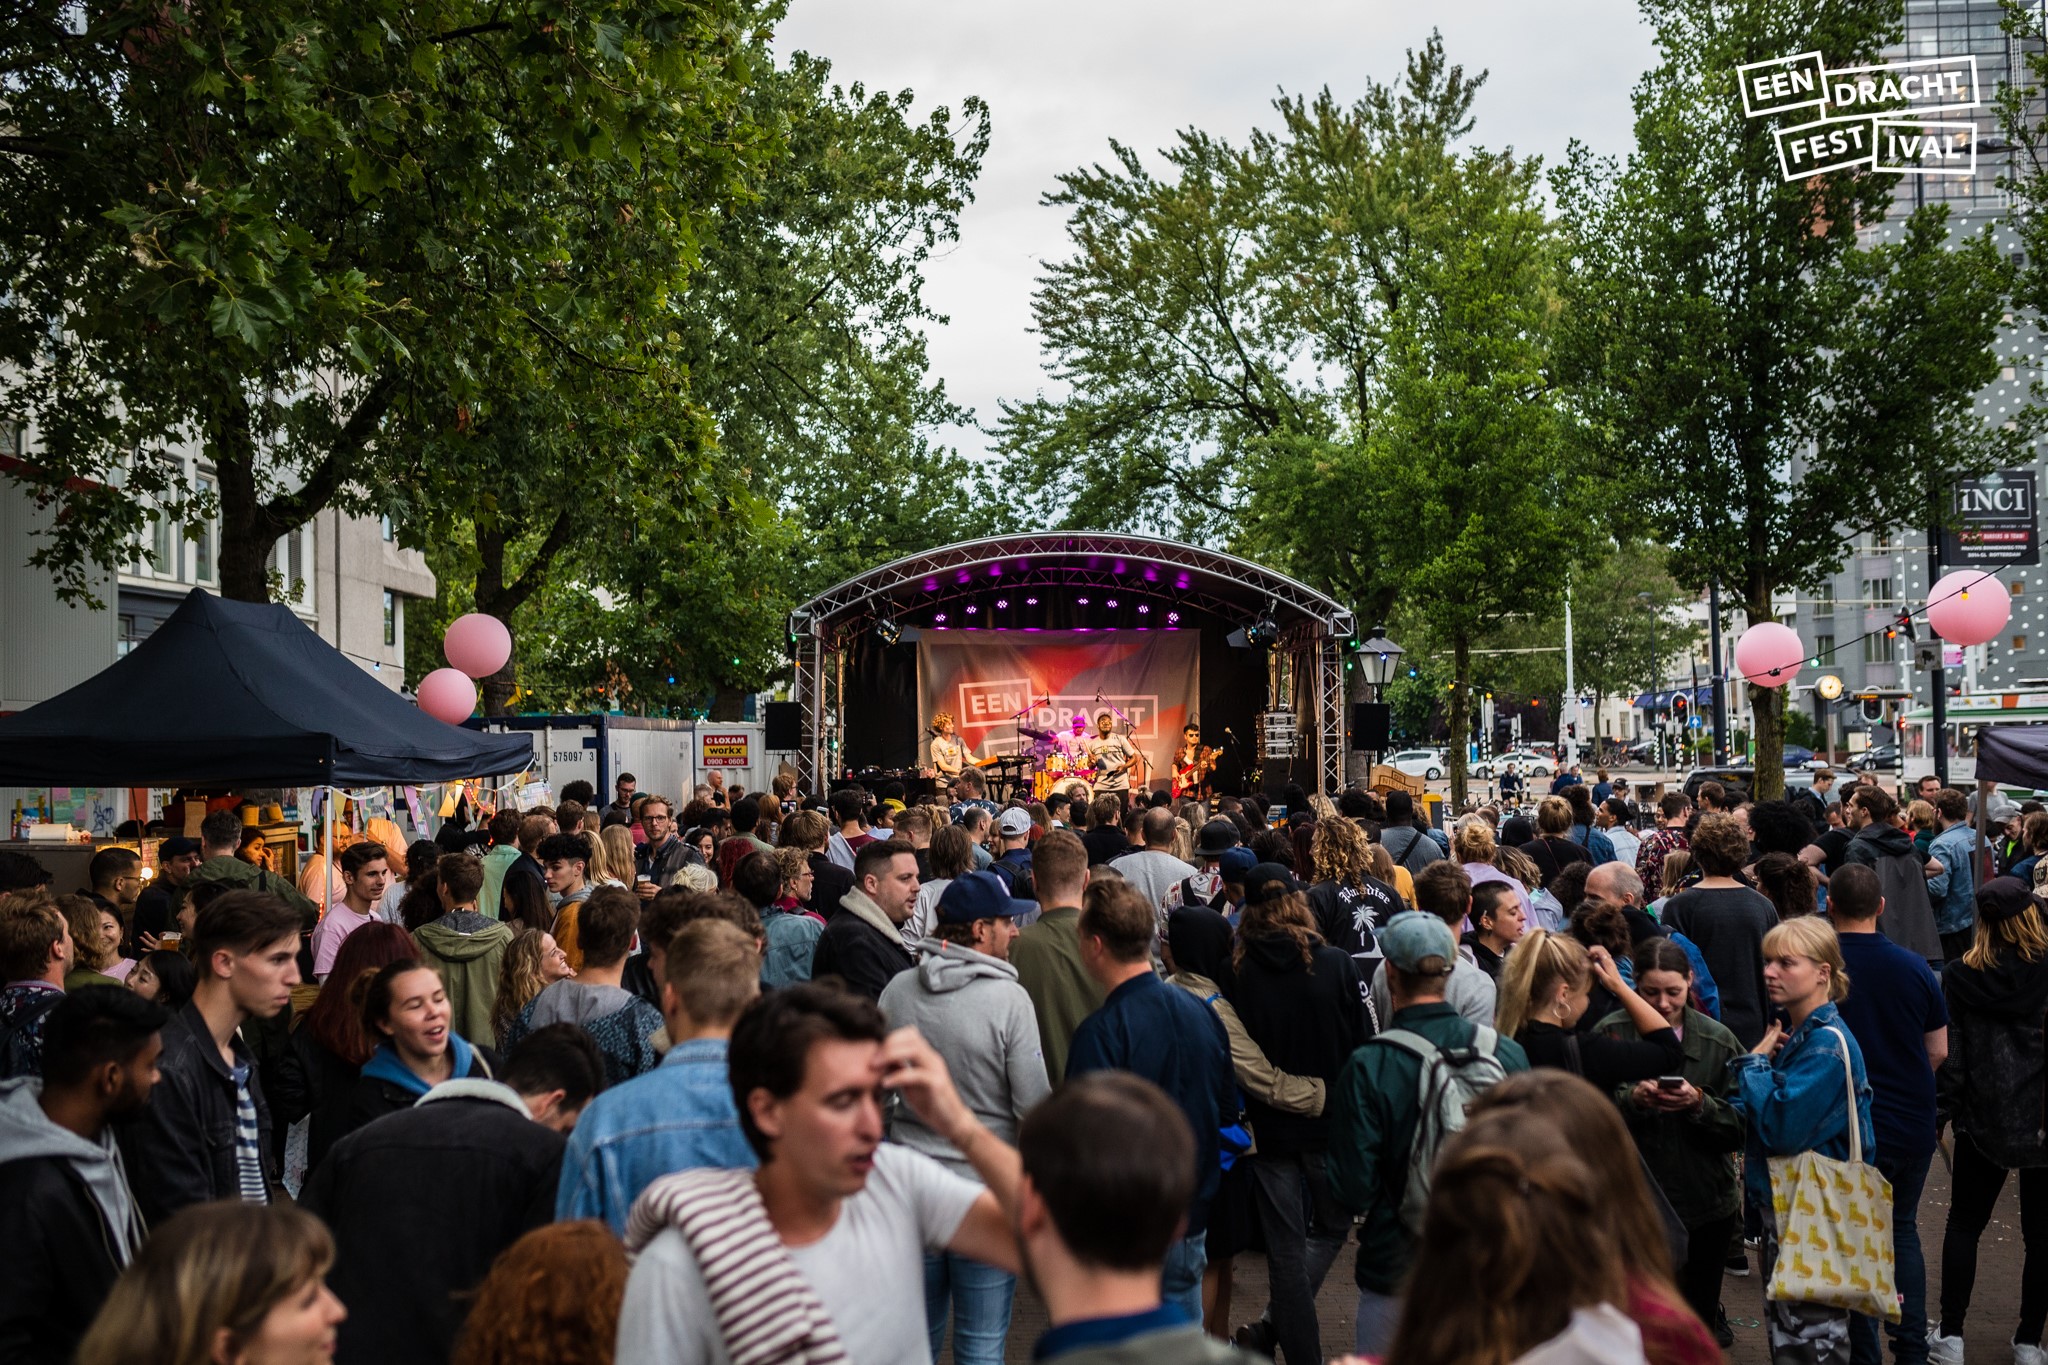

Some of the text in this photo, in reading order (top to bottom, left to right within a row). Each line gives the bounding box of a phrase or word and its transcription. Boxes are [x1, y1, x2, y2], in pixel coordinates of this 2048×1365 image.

[971, 692, 1022, 715] EEN
[709, 746, 742, 755] workx
[553, 752, 583, 762] 575097
[589, 752, 594, 762] 3
